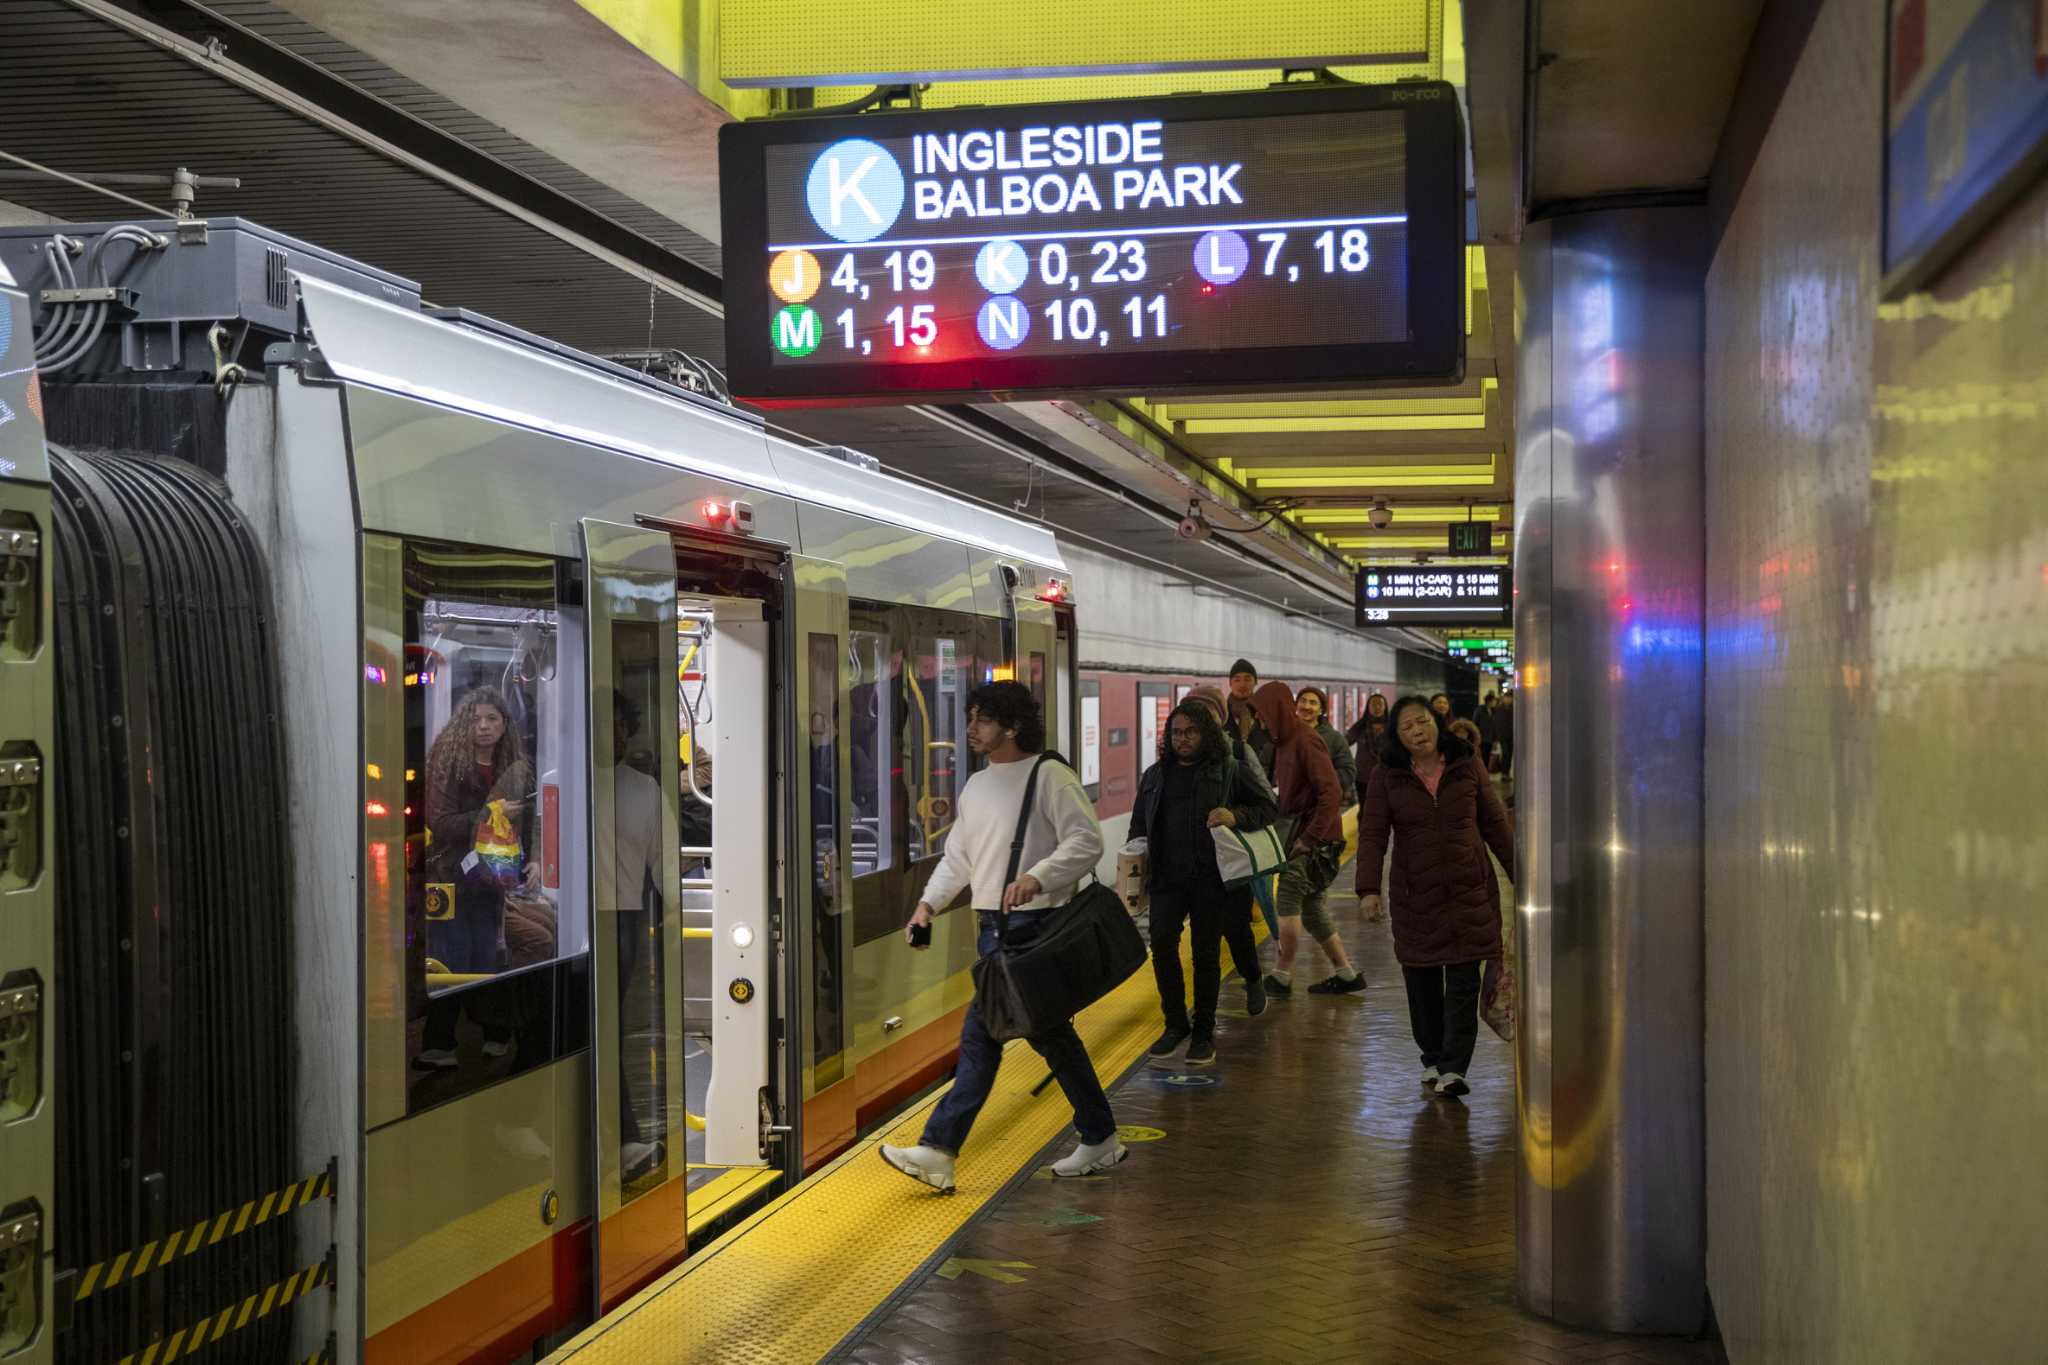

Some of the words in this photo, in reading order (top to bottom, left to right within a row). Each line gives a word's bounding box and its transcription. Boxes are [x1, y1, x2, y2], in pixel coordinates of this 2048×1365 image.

[913, 121, 1164, 174] INGLESIDE
[827, 154, 886, 228] K
[914, 172, 1102, 221] BALBOA
[1113, 163, 1243, 210] PARK
[783, 257, 804, 296] J
[830, 252, 870, 301] 4,
[883, 249, 936, 293] 19
[984, 246, 1023, 286] K
[1039, 242, 1079, 292] 0,
[1090, 239, 1147, 283] 23
[1209, 238, 1236, 276] L
[1257, 231, 1298, 282] 7,
[1315, 228, 1369, 273] 18
[779, 309, 816, 348] M
[836, 308, 871, 355] 1,
[885, 304, 937, 348] 15
[987, 304, 1022, 341] N
[1044, 298, 1109, 347] 10,
[1123, 294, 1166, 340] 11
[1455, 526, 1480, 550] EXIT
[1381, 586, 1393, 597] 10
[1394, 586, 1414, 597] MIN
[1457, 586, 1465, 597] &
[1466, 586, 1478, 597] 11
[1480, 586, 1499, 596] MIN
[1386, 575, 1393, 585] 1
[1394, 575, 1414, 586] MIN
[1457, 574, 1465, 585] &
[1480, 574, 1499, 585] MIN
